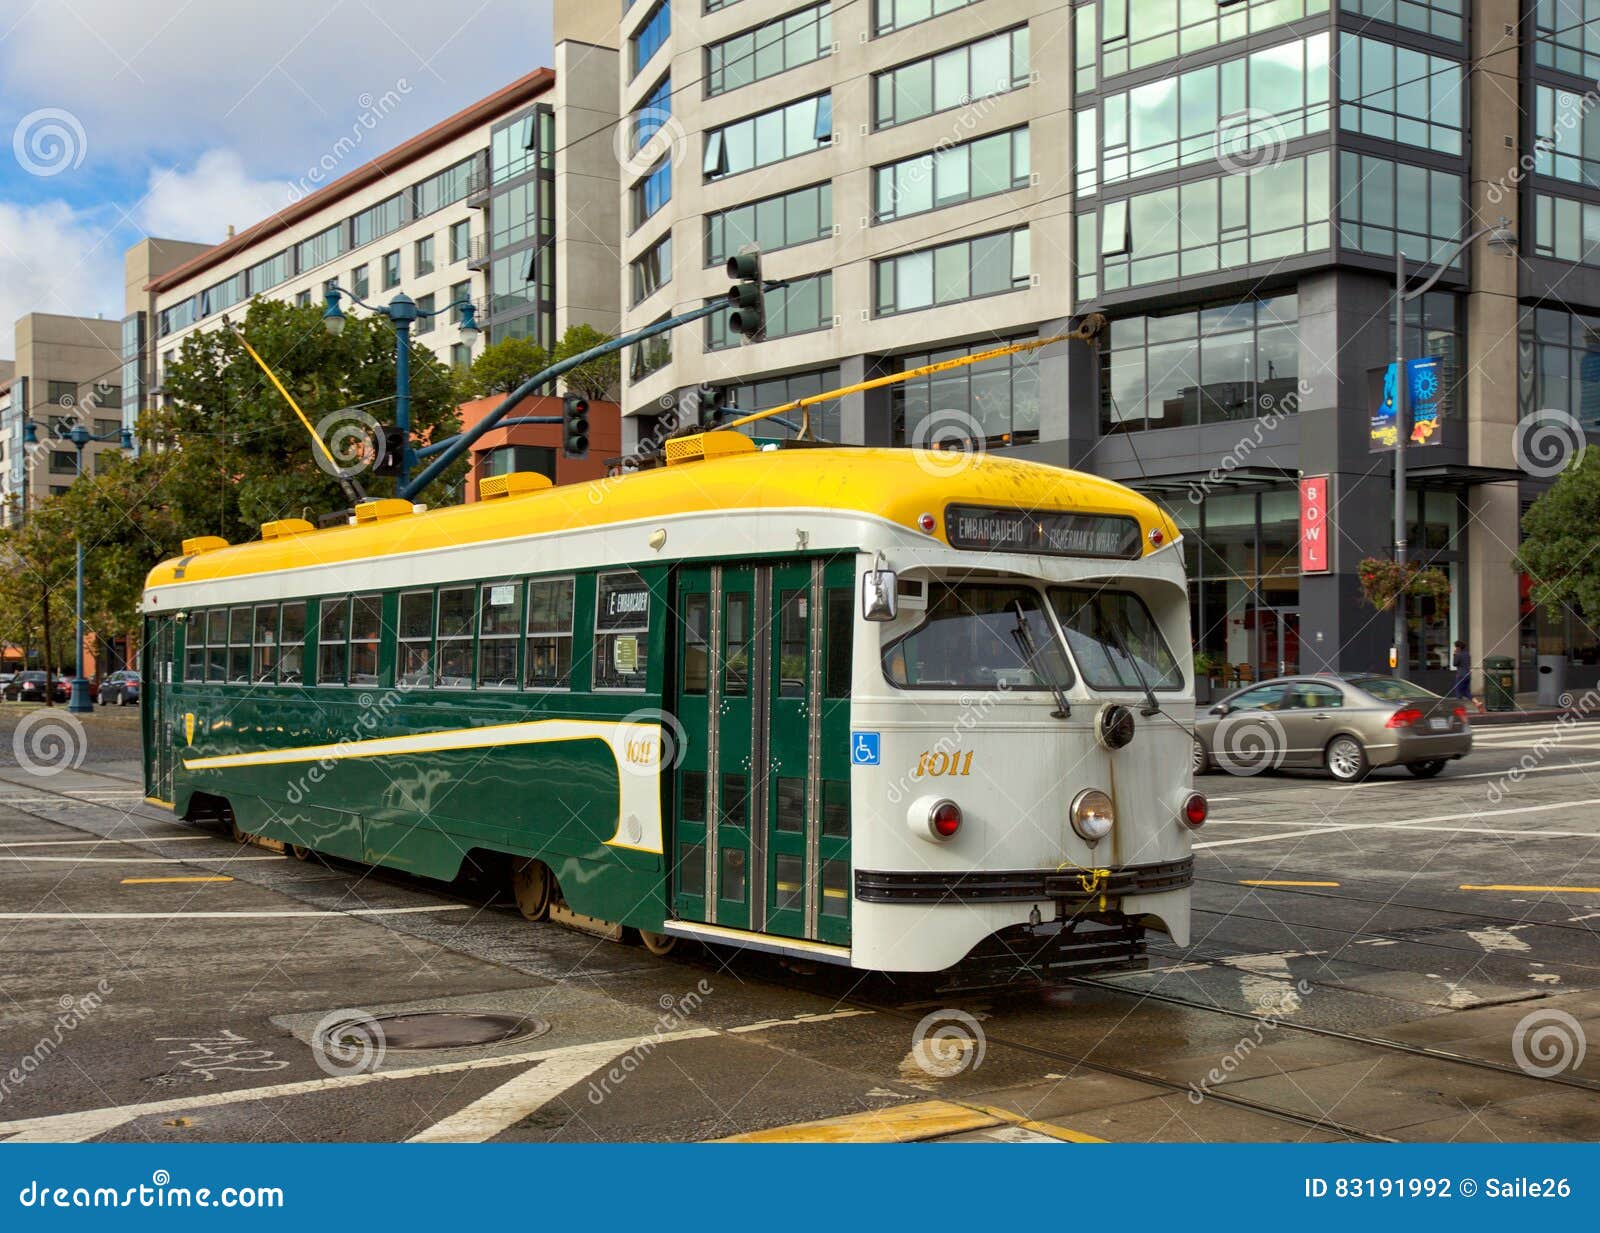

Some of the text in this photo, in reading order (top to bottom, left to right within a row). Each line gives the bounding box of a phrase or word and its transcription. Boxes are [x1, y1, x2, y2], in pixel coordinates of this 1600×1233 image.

[958, 517, 1024, 542] EMBARCADERO
[1306, 487, 1320, 560] BOWL
[609, 592, 616, 615] E
[626, 741, 650, 763] 1011
[916, 750, 974, 776] 1011
